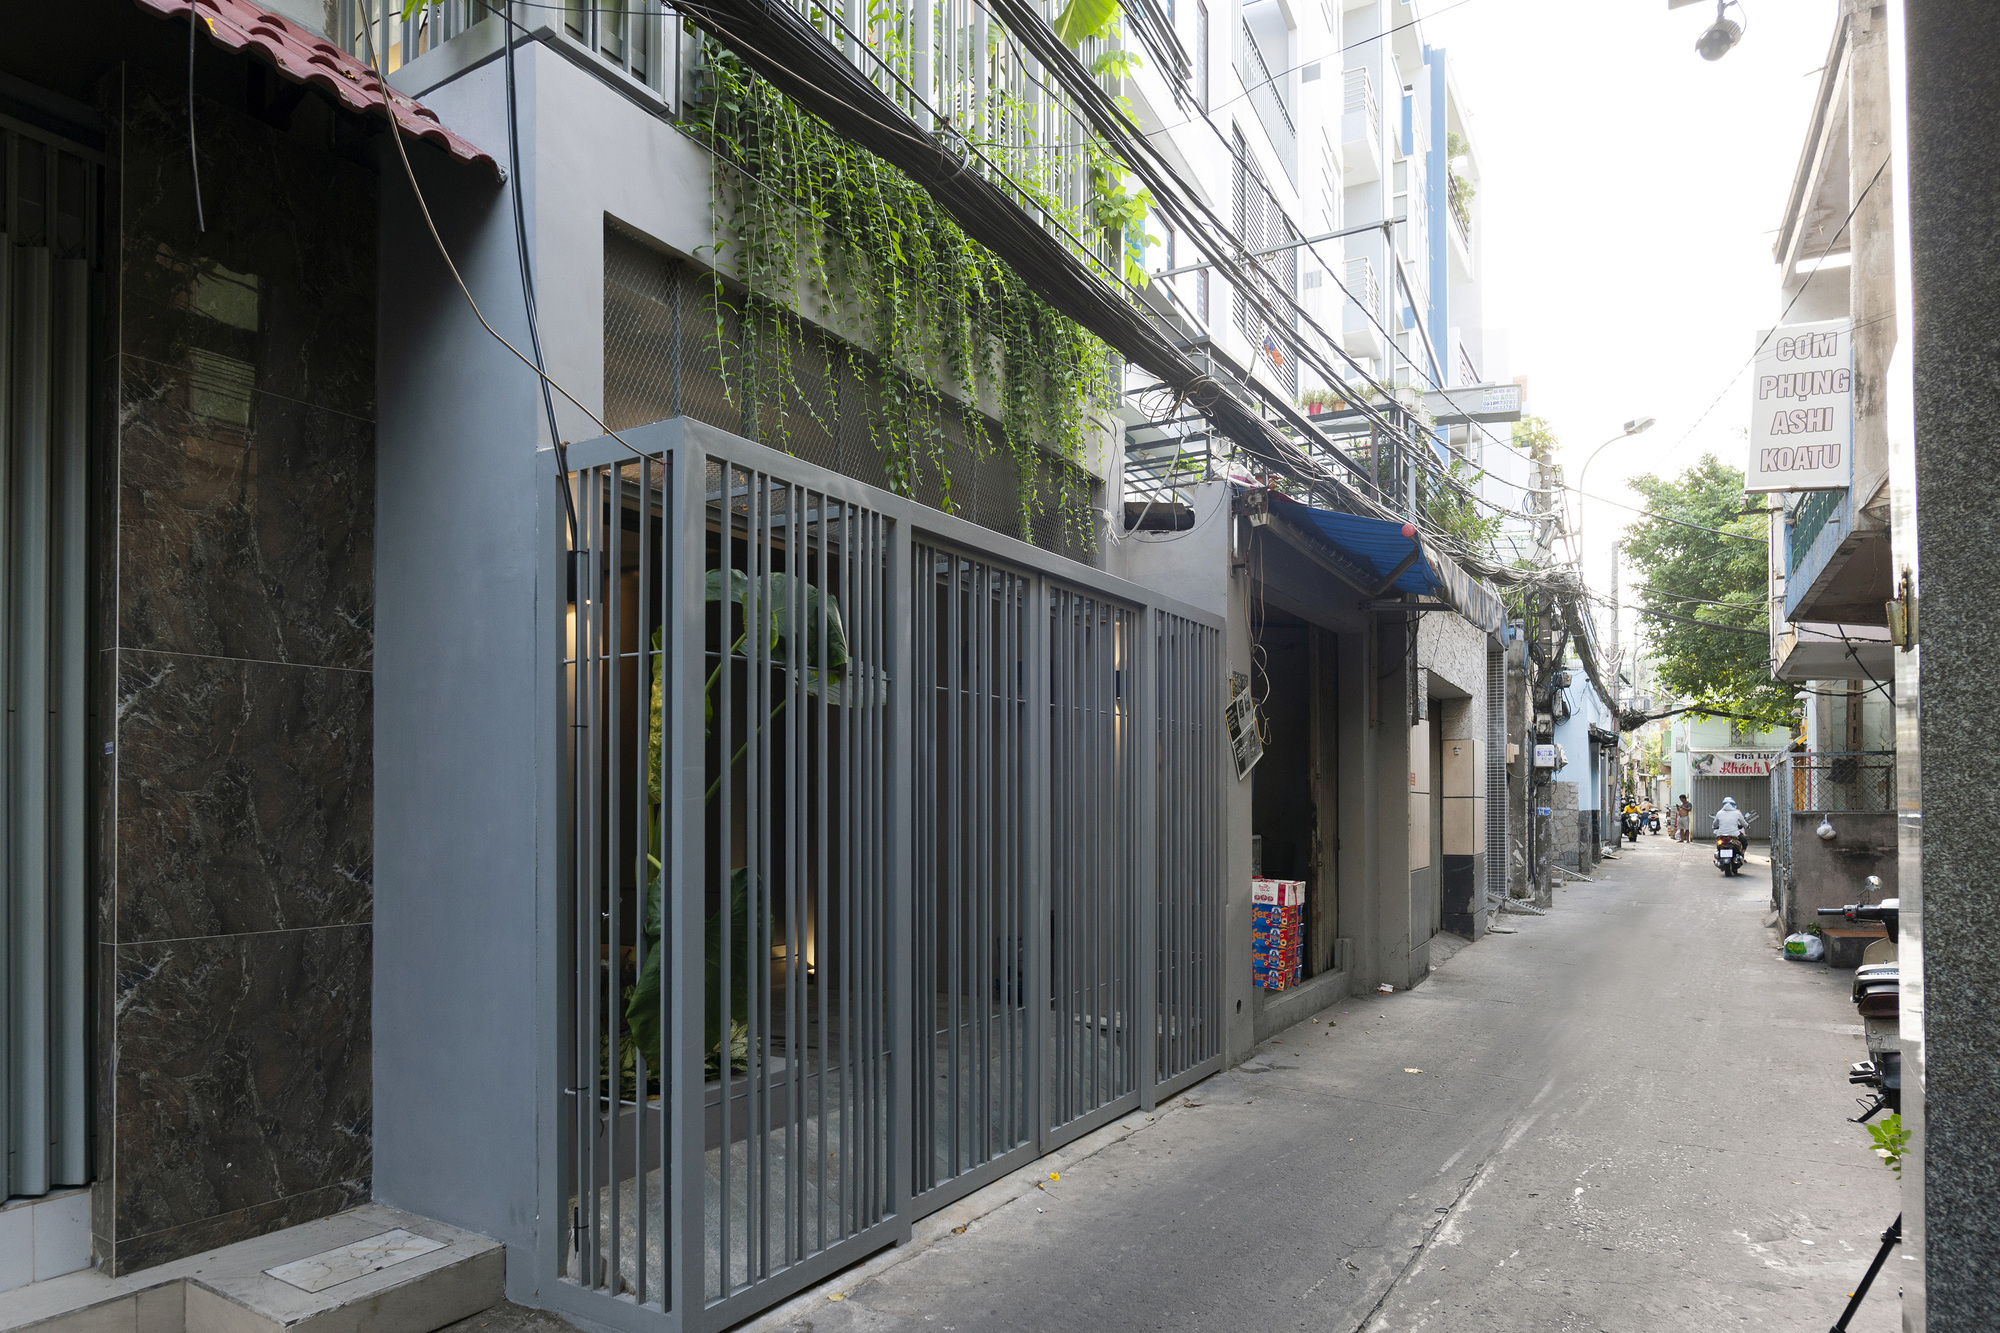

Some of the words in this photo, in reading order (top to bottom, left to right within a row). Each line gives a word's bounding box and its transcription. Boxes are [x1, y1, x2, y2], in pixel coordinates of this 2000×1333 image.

[1776, 332, 1838, 361] CƠM
[1759, 368, 1850, 401] PHỤNG
[1770, 407, 1834, 435] ASHI
[1760, 444, 1841, 472] KOATU
[1719, 761, 1764, 774] Khánh
